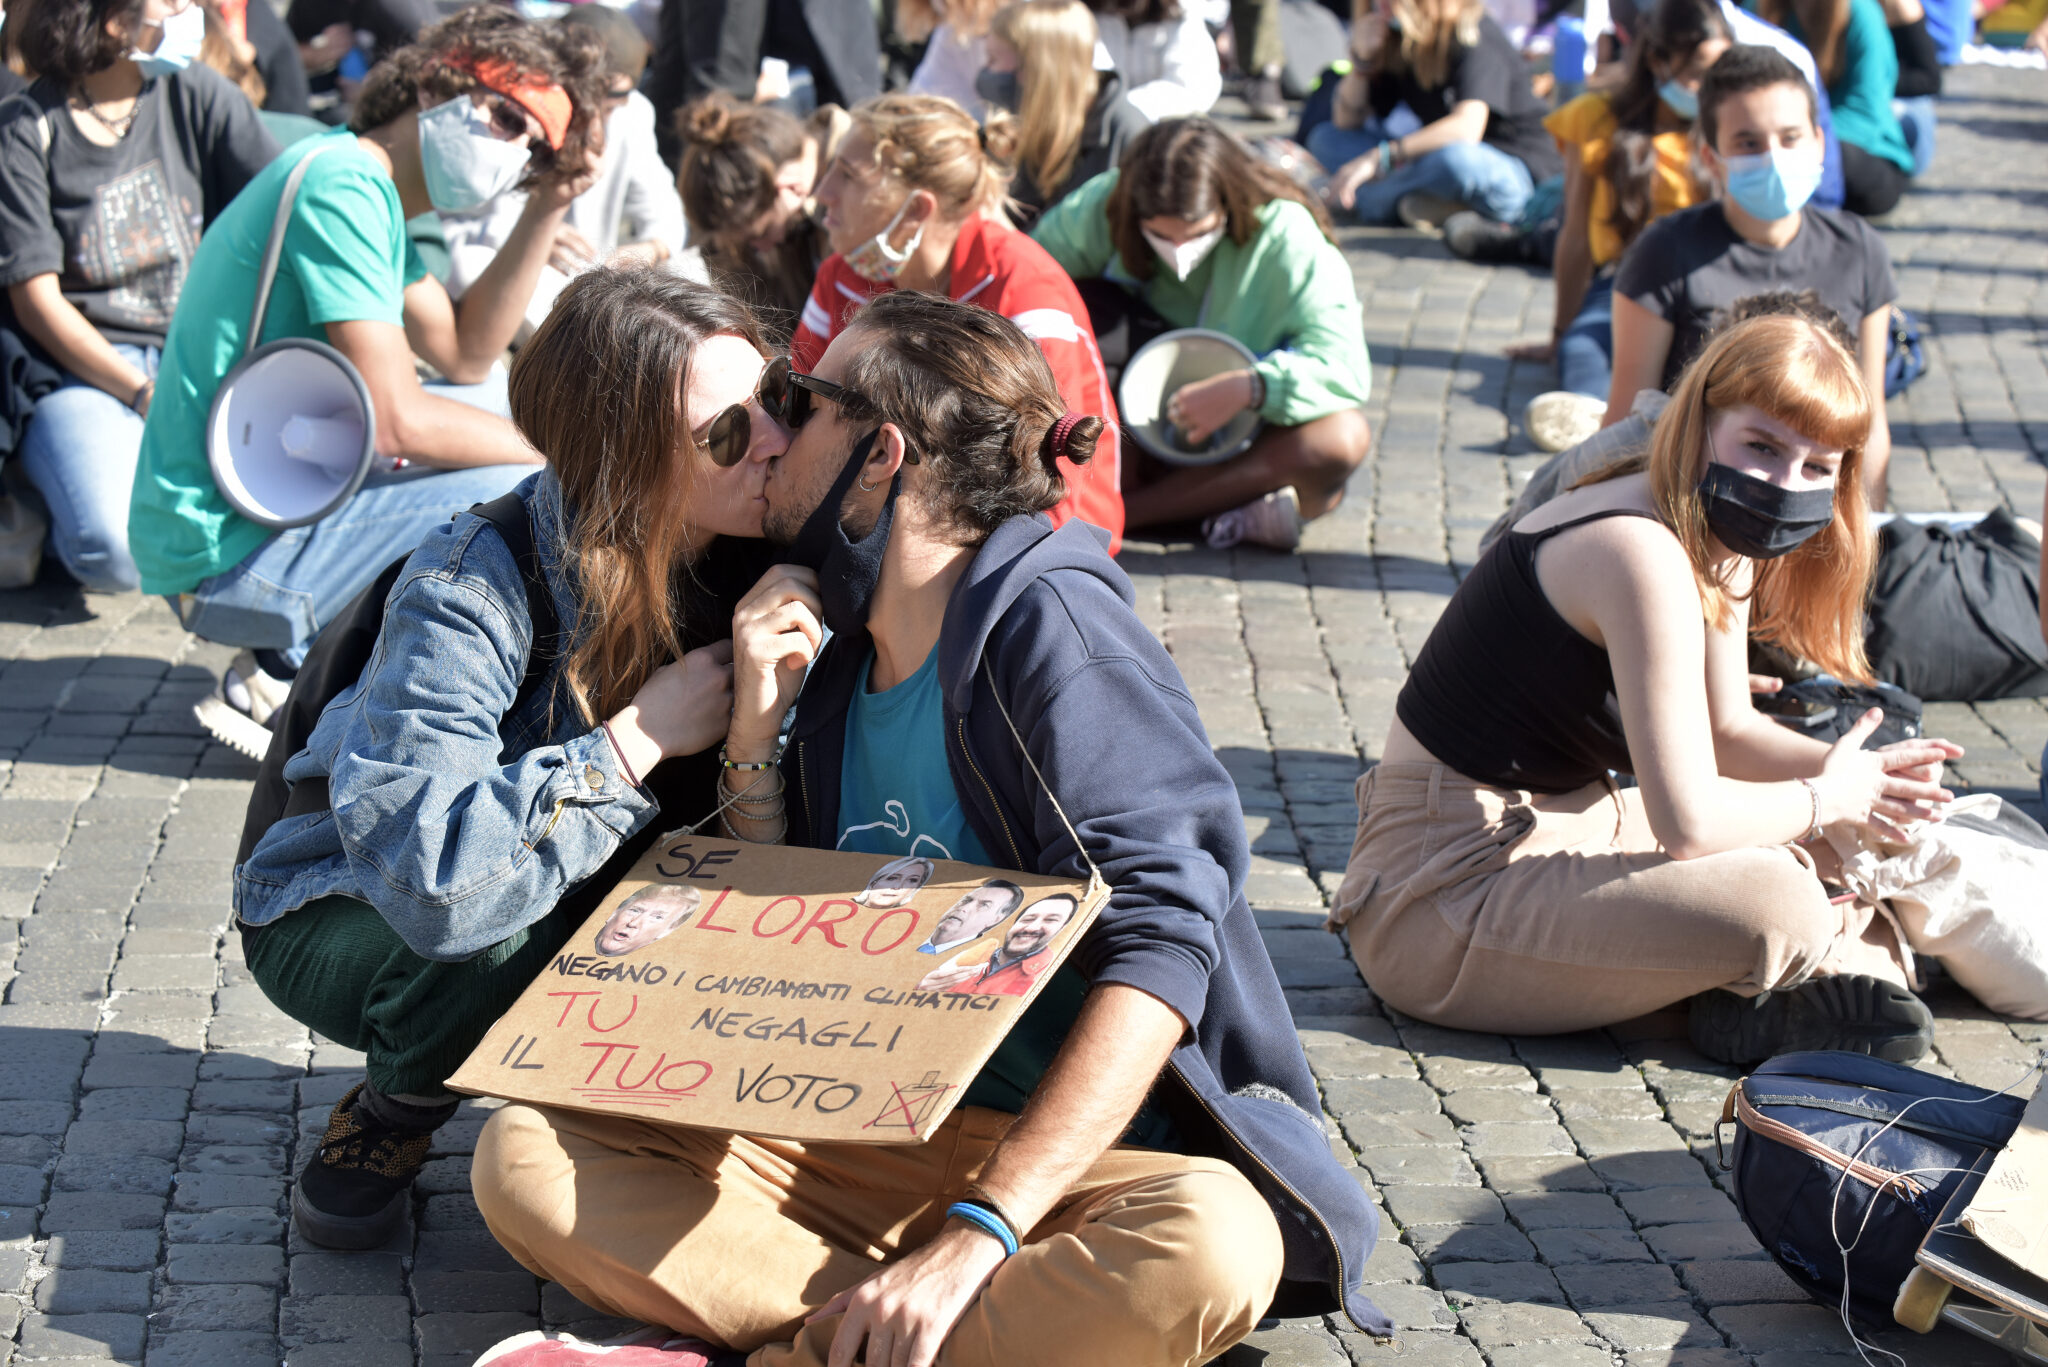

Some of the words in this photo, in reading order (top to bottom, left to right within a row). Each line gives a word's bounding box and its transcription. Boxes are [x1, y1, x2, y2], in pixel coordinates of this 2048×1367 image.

[656, 843, 740, 879] SE
[695, 885, 920, 956] LORO
[549, 952, 667, 986] NEGANO
[673, 970, 686, 987] I
[694, 974, 852, 1001] CAMBIAMENTI
[864, 986, 1001, 1012] CLIMATICI
[547, 991, 638, 1033] TU
[690, 1006, 904, 1052] NEGAGLI
[500, 1034, 544, 1070] IL
[580, 1042, 713, 1092] TUO
[736, 1063, 862, 1114] VOTO
